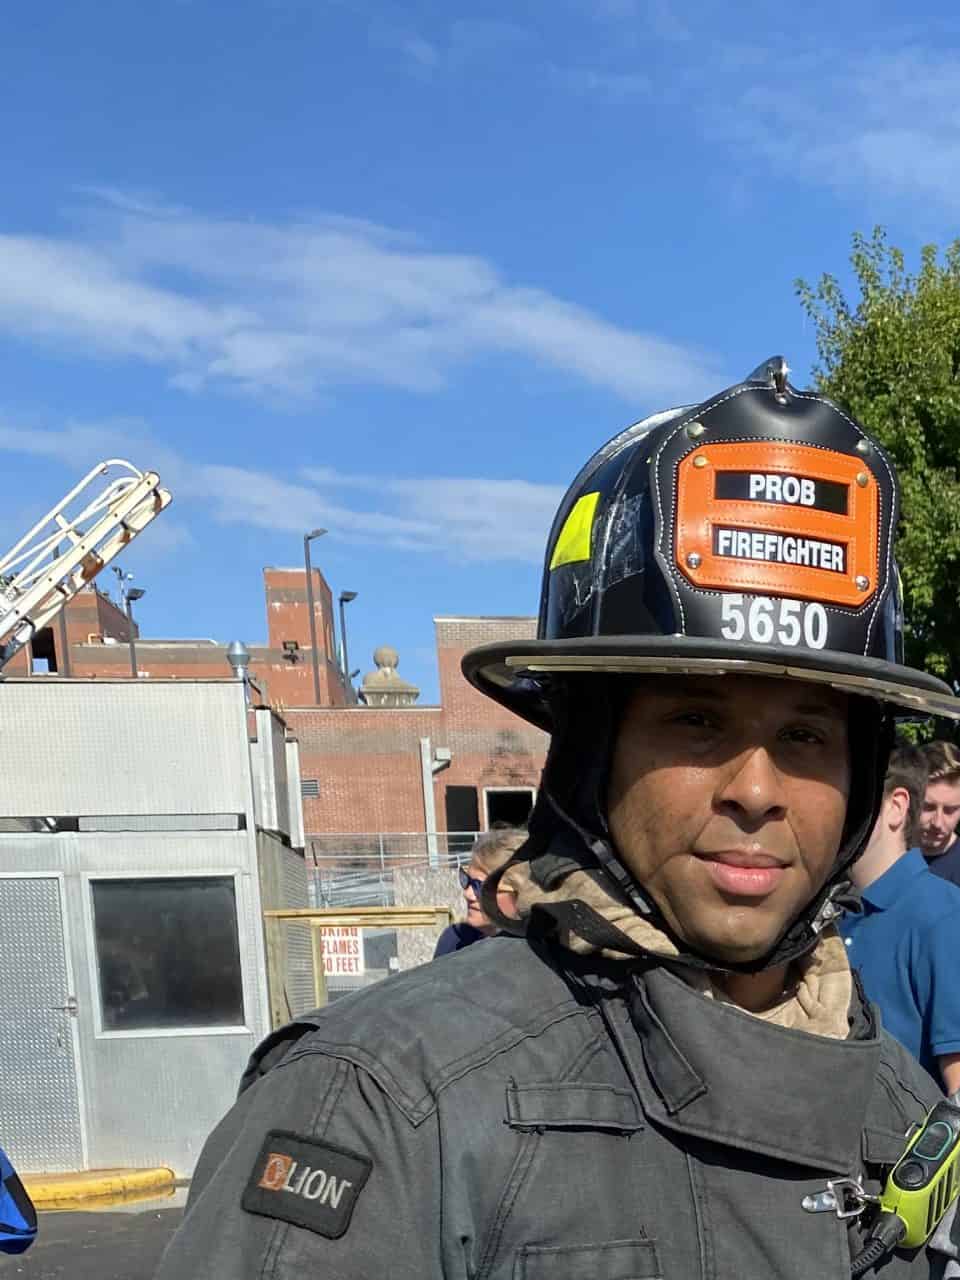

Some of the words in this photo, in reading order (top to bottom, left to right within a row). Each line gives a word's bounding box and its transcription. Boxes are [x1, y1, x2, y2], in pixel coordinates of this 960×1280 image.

[749, 474, 816, 506] PROB
[717, 530, 845, 573] FIREFIGHTER
[720, 593, 829, 650] 5650
[336, 957, 360, 972] FEET
[282, 1161, 352, 1209] LION
